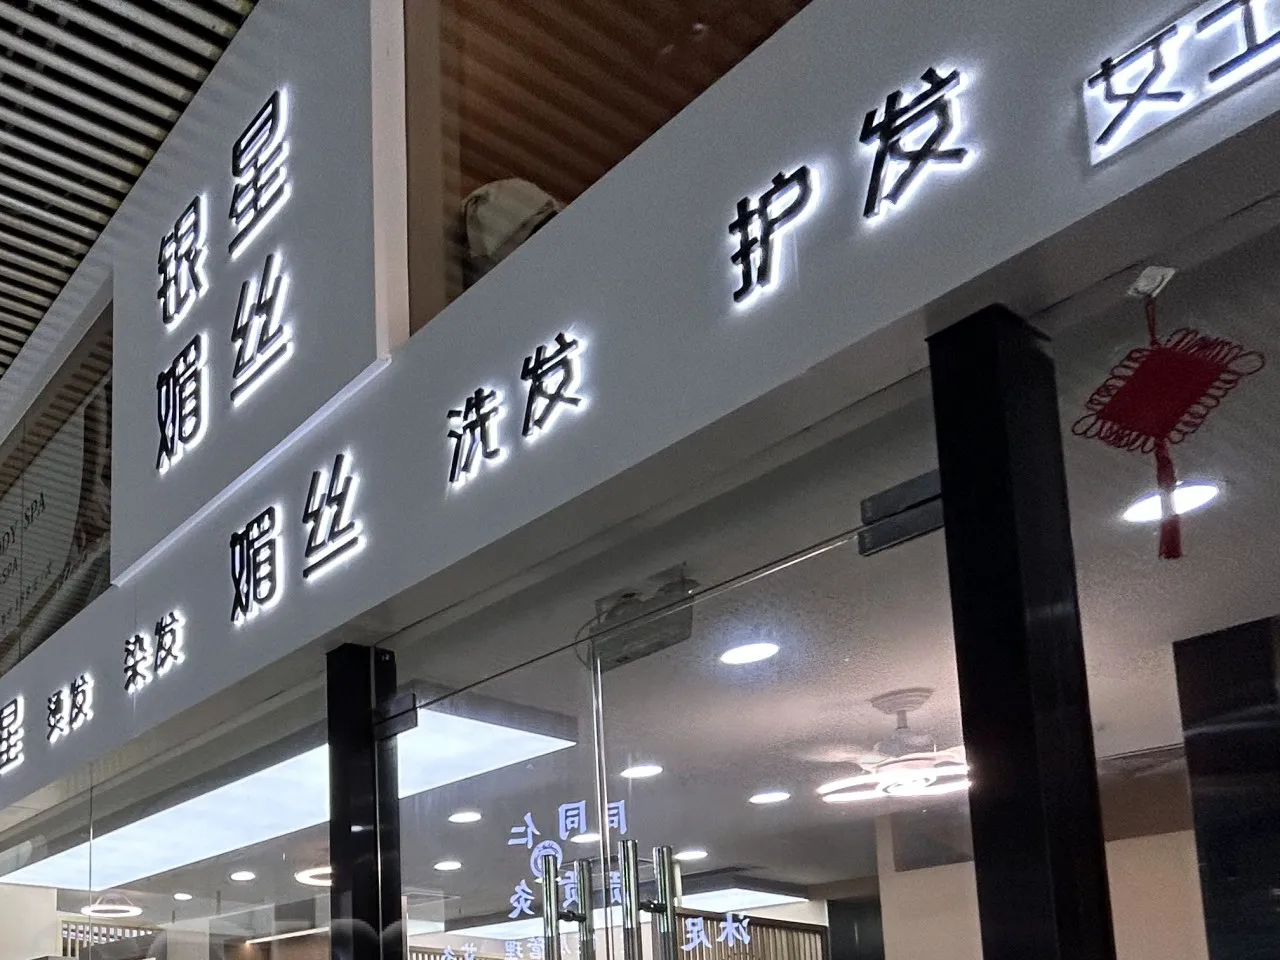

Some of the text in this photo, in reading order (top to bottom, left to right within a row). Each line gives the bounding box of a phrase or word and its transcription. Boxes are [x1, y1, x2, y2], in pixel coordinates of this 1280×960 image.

[45, 673, 95, 744] 烫发
[124, 611, 186, 693] 染发
[229, 452, 369, 626] 媚丝
[447, 330, 586, 490] 洗发
[728, 66, 972, 306] 护发
